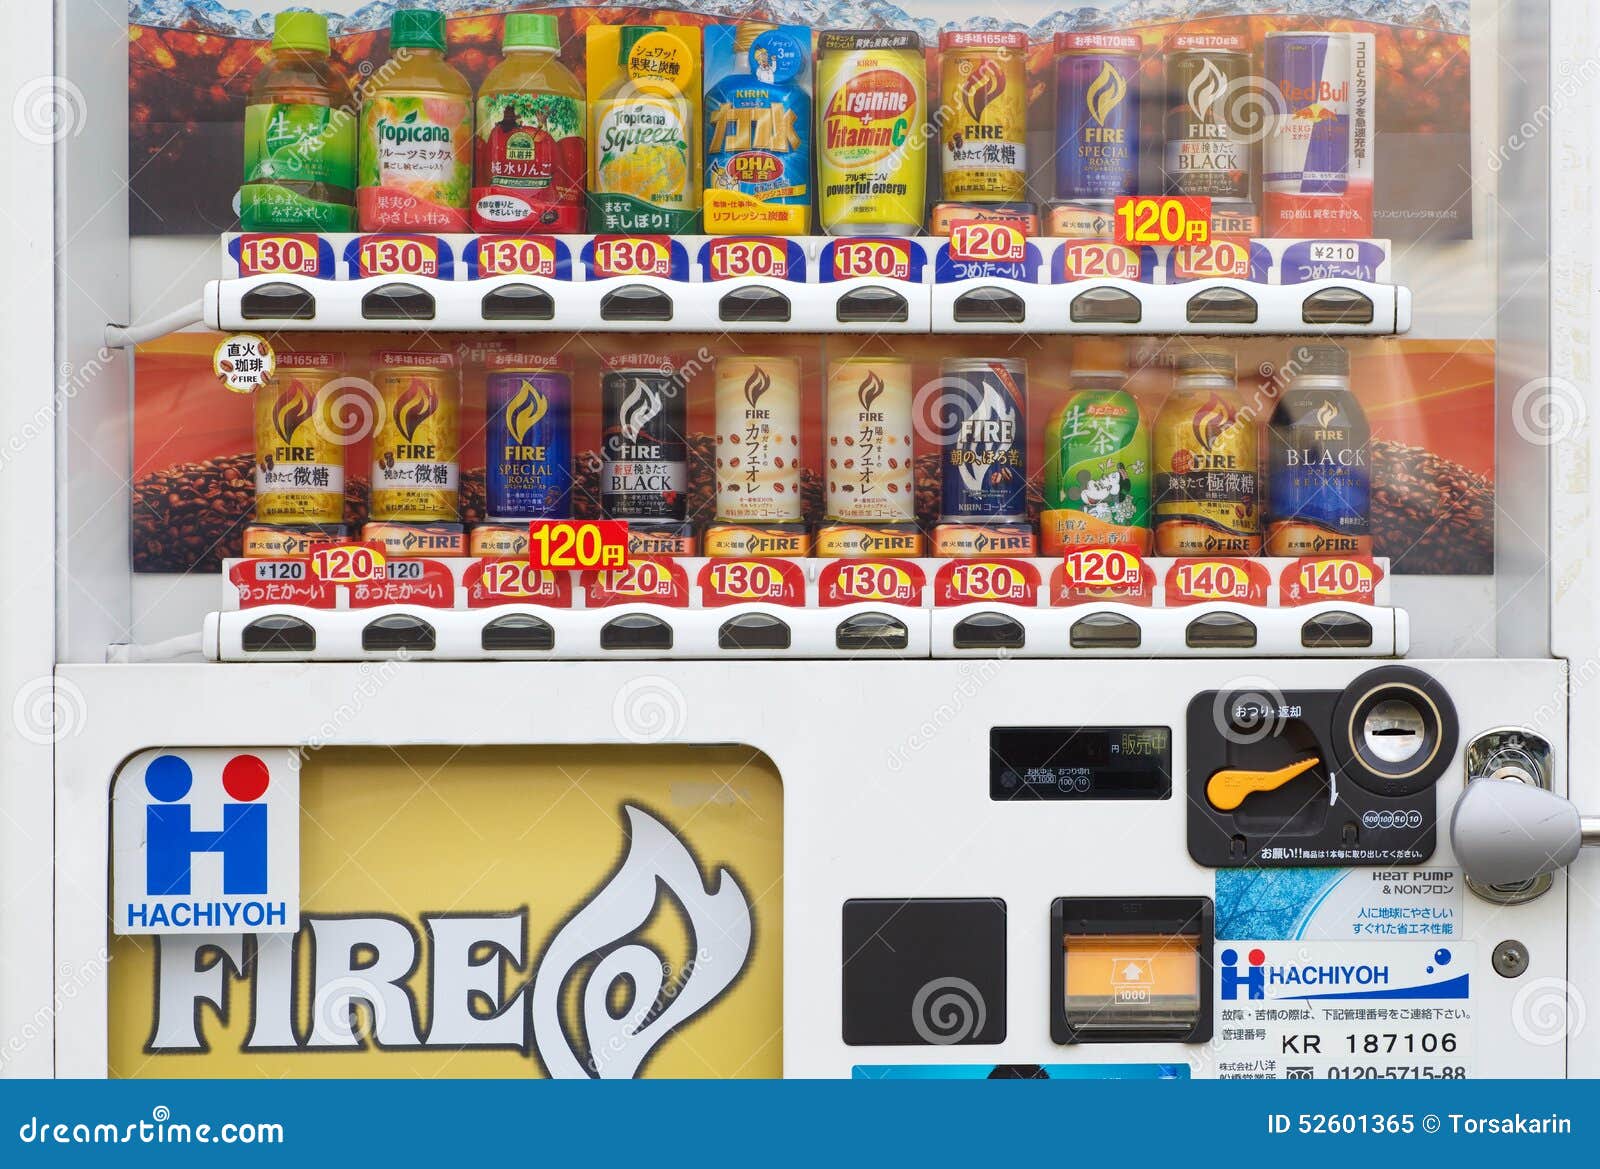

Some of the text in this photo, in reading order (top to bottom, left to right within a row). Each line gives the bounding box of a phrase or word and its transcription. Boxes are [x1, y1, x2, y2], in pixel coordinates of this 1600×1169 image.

[736, 89, 769, 99] KIRIN
[1320, 81, 1348, 101] Bull
[832, 88, 907, 114] Arginine
[614, 110, 665, 126] Tropicana
[377, 118, 450, 144] Tropicana
[965, 125, 1003, 139] FIRE
[1085, 128, 1124, 143] FIRE
[1189, 124, 1227, 138] FIRE
[601, 127, 680, 153] Squeeze
[1078, 145, 1128, 157] SPECIAL
[736, 158, 776, 171] DHA
[1178, 154, 1237, 170] BLACK
[827, 182, 907, 197] powerful energy
[605, 202, 631, 212] まるで
[605, 214, 670, 229] 手しぼり!
[1118, 200, 1209, 245] 120円
[1212, 218, 1252, 232] FIRE
[956, 227, 1024, 258] 120円
[244, 241, 317, 273] 130円
[363, 242, 436, 274] 130円
[481, 242, 554, 273] 130円
[598, 242, 669, 273] 130円
[714, 245, 785, 276] 130円
[838, 245, 908, 276] 130円
[1178, 244, 1248, 275] 120円
[1315, 247, 1355, 260] ¥210
[1070, 246, 1138, 277] 120円
[228, 343, 255, 357] 直火
[235, 359, 263, 373] 珈琲
[239, 375, 257, 383] FIRE
[746, 410, 769, 419] FIRE
[859, 413, 883, 422] FIRE
[960, 419, 1014, 444] FIRE
[1314, 430, 1343, 441] FIRE
[276, 447, 315, 461] FIRE
[397, 445, 435, 459] FIRE
[506, 446, 545, 461] FIRE
[622, 445, 661, 458] FIRE
[1286, 449, 1365, 466] BLACK
[745, 424, 760, 495] カフェオレ
[859, 426, 874, 495] カフェオレ
[1193, 454, 1236, 468] FIRE
[499, 464, 552, 475] SPECIAL
[509, 476, 541, 484] ROAST
[611, 476, 671, 490] BLACK
[418, 536, 460, 548] FIRE
[532, 524, 624, 566] 120円
[644, 540, 684, 552] FIRE
[760, 538, 799, 551] FIRE
[874, 537, 914, 549] FIRE
[990, 537, 1031, 550] FIRE
[1218, 539, 1249, 551] FIRE
[1325, 538, 1358, 550] FIRE
[260, 564, 302, 579] ¥120
[313, 550, 384, 580] 120円
[1069, 553, 1138, 583] 120円
[485, 564, 553, 594] 120円
[601, 564, 670, 594] 120円
[713, 565, 782, 596] 130円
[841, 566, 910, 598] 130円
[955, 566, 1024, 598] 130円
[1180, 566, 1248, 597] 140円
[1303, 564, 1372, 594] 140円
[1122, 734, 1167, 755] 販売中
[128, 902, 286, 928] HACHIYOH
[1358, 908, 1453, 919] 人に地球にやさしい
[1353, 923, 1453, 935] すぐれた省エネ性能
[151, 914, 527, 1051] FIRE
[1270, 966, 1388, 984] HACHIYOH
[1120, 990, 1145, 1001] 1000
[1222, 1029, 1266, 1040] 管理番号
[1282, 1033, 1457, 1054] KR 187106
[1219, 1060, 1276, 1071] 株式会社八洋
